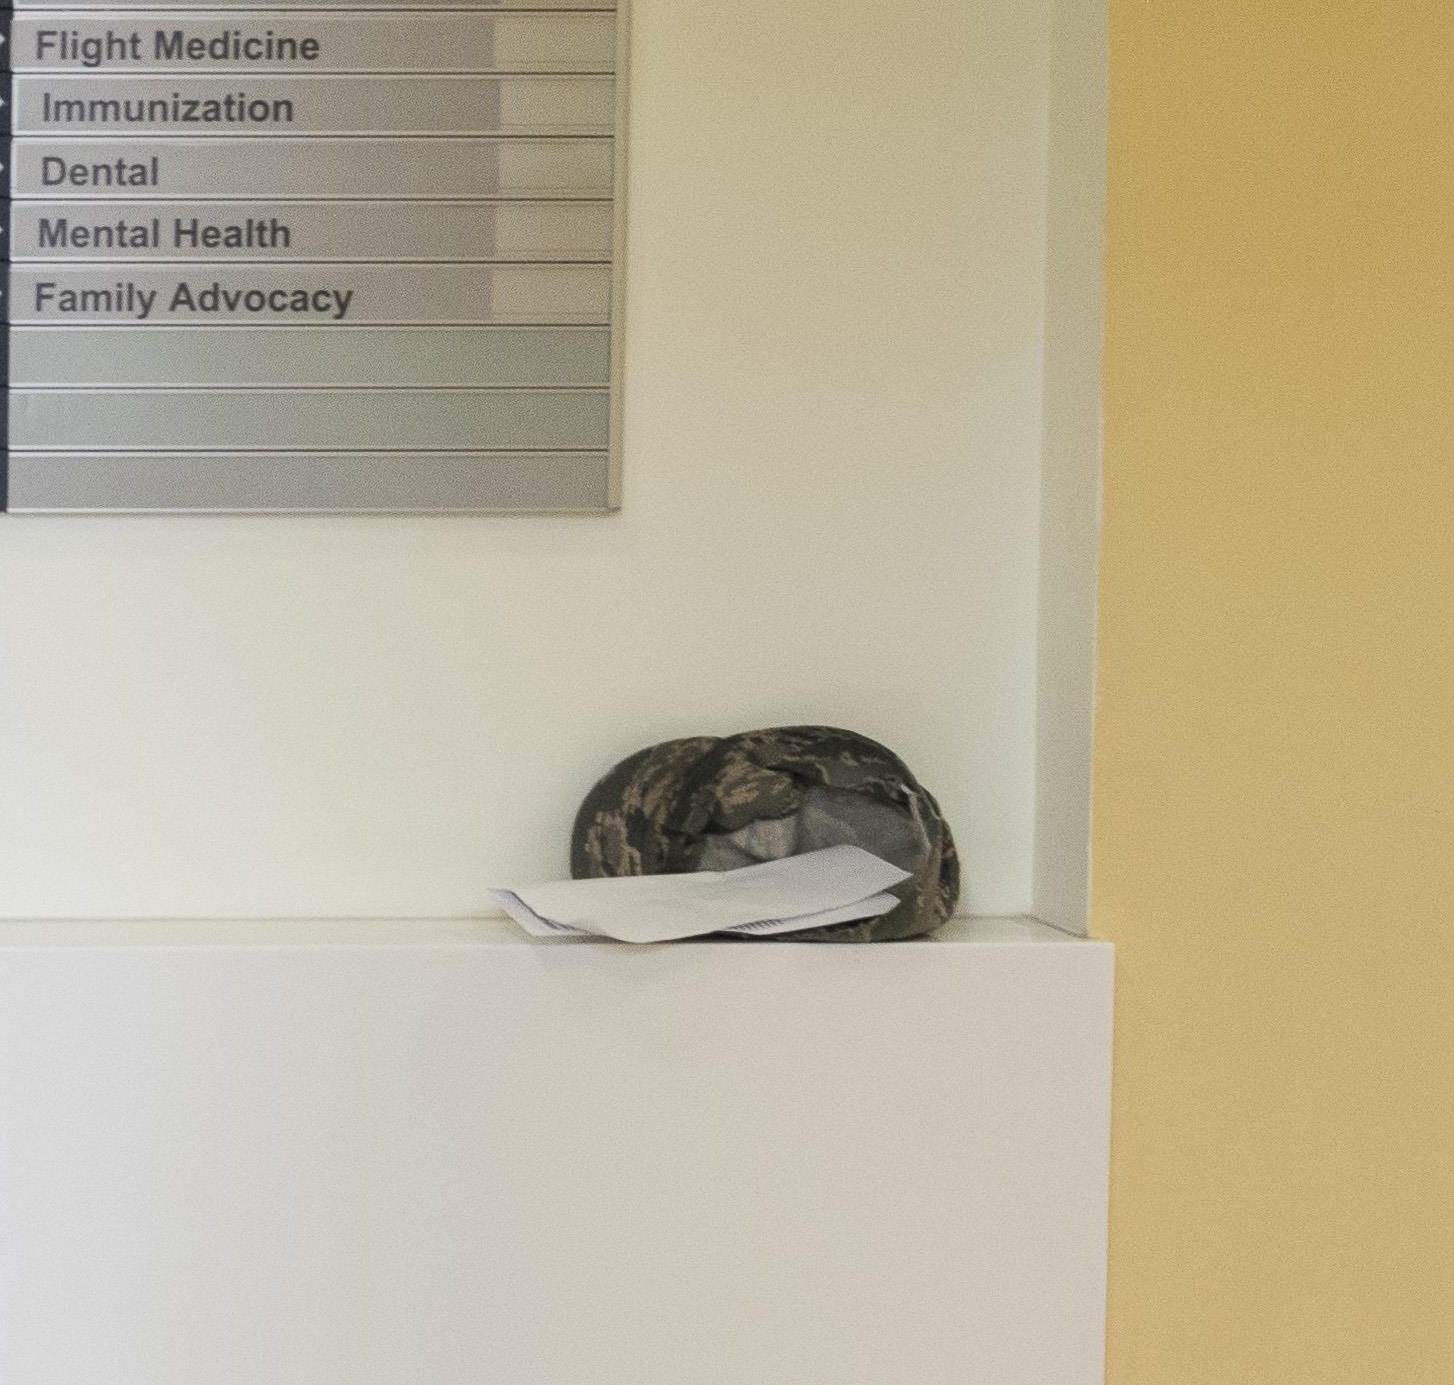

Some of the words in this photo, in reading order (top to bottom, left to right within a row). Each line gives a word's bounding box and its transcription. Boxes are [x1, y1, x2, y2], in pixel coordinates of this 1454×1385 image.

[36, 30, 142, 68] Flight
[155, 30, 320, 61] Medicine
[44, 92, 294, 123] Immunization
[42, 156, 159, 187] Dental
[39, 218, 160, 249] Mental
[174, 218, 291, 249] Health
[35, 282, 158, 320] Family
[169, 282, 354, 320] Advocacy
